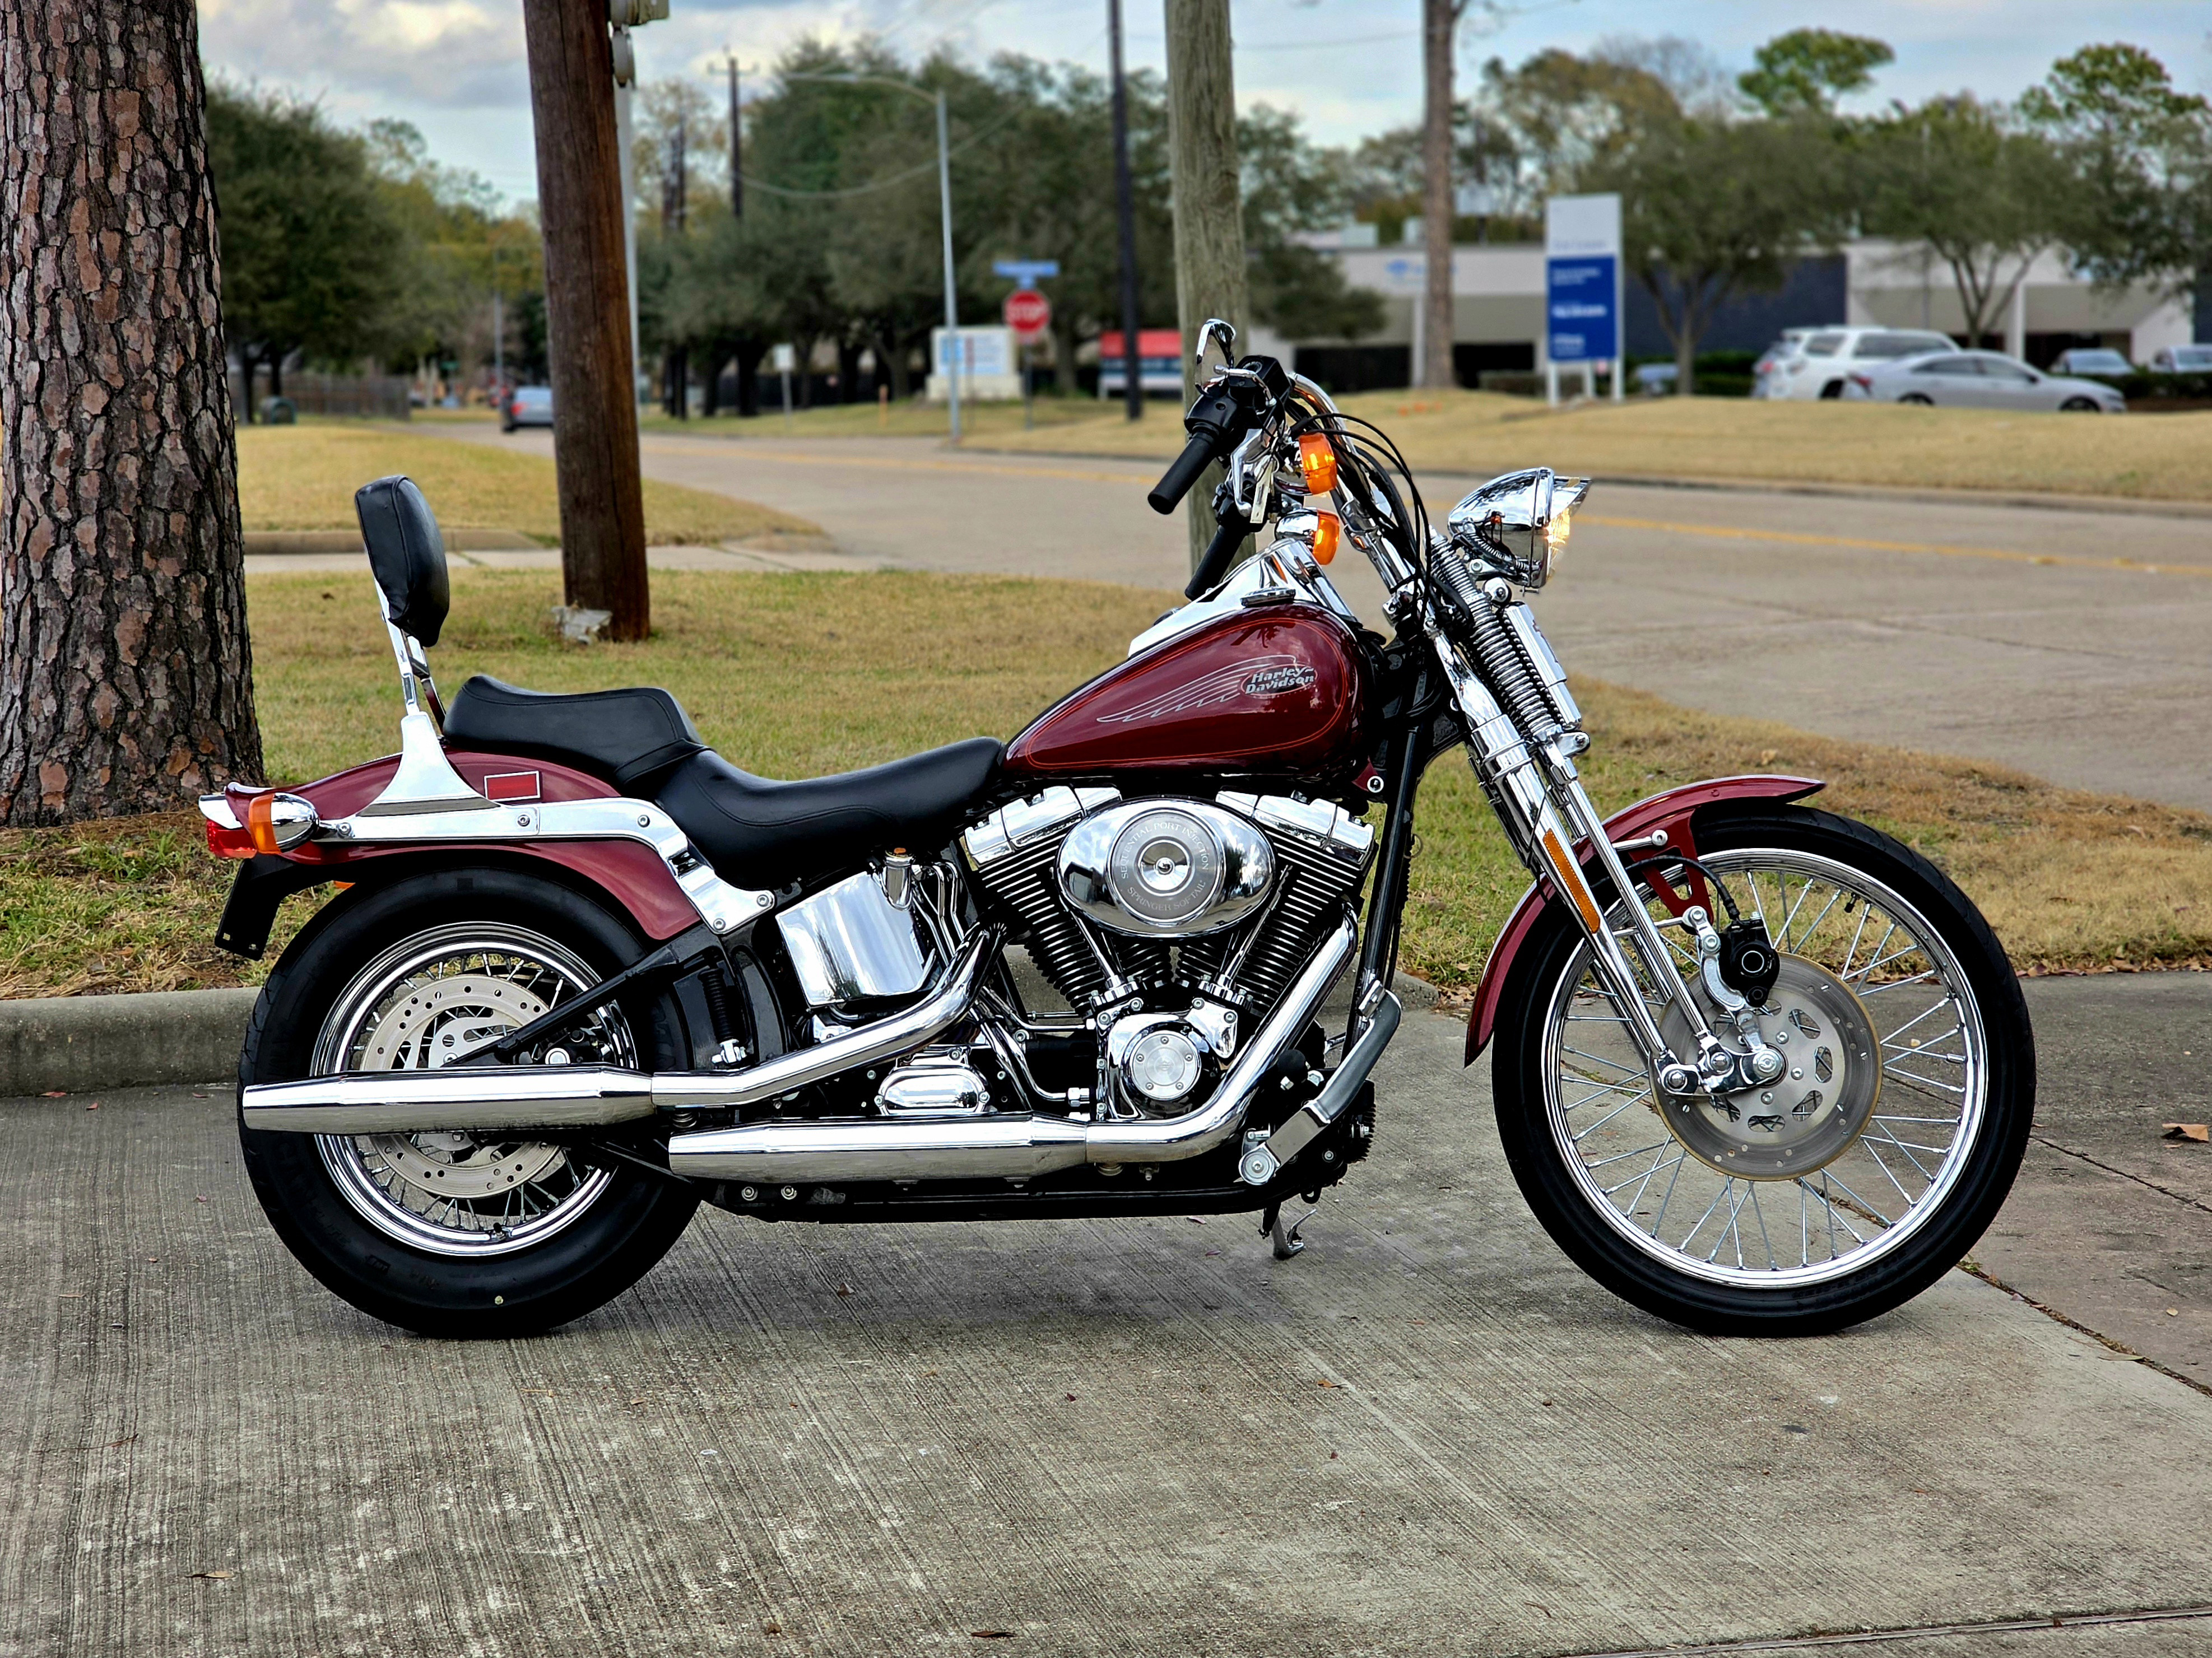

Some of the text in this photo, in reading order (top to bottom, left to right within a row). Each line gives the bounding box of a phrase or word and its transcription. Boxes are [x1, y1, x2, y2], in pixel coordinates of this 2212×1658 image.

[1245, 675, 1314, 695] Davidson
[1121, 822, 1209, 879] SEQUENTIAL PORT INJECTION
[1127, 882, 1206, 911] SPRINGER SOFTAIL
